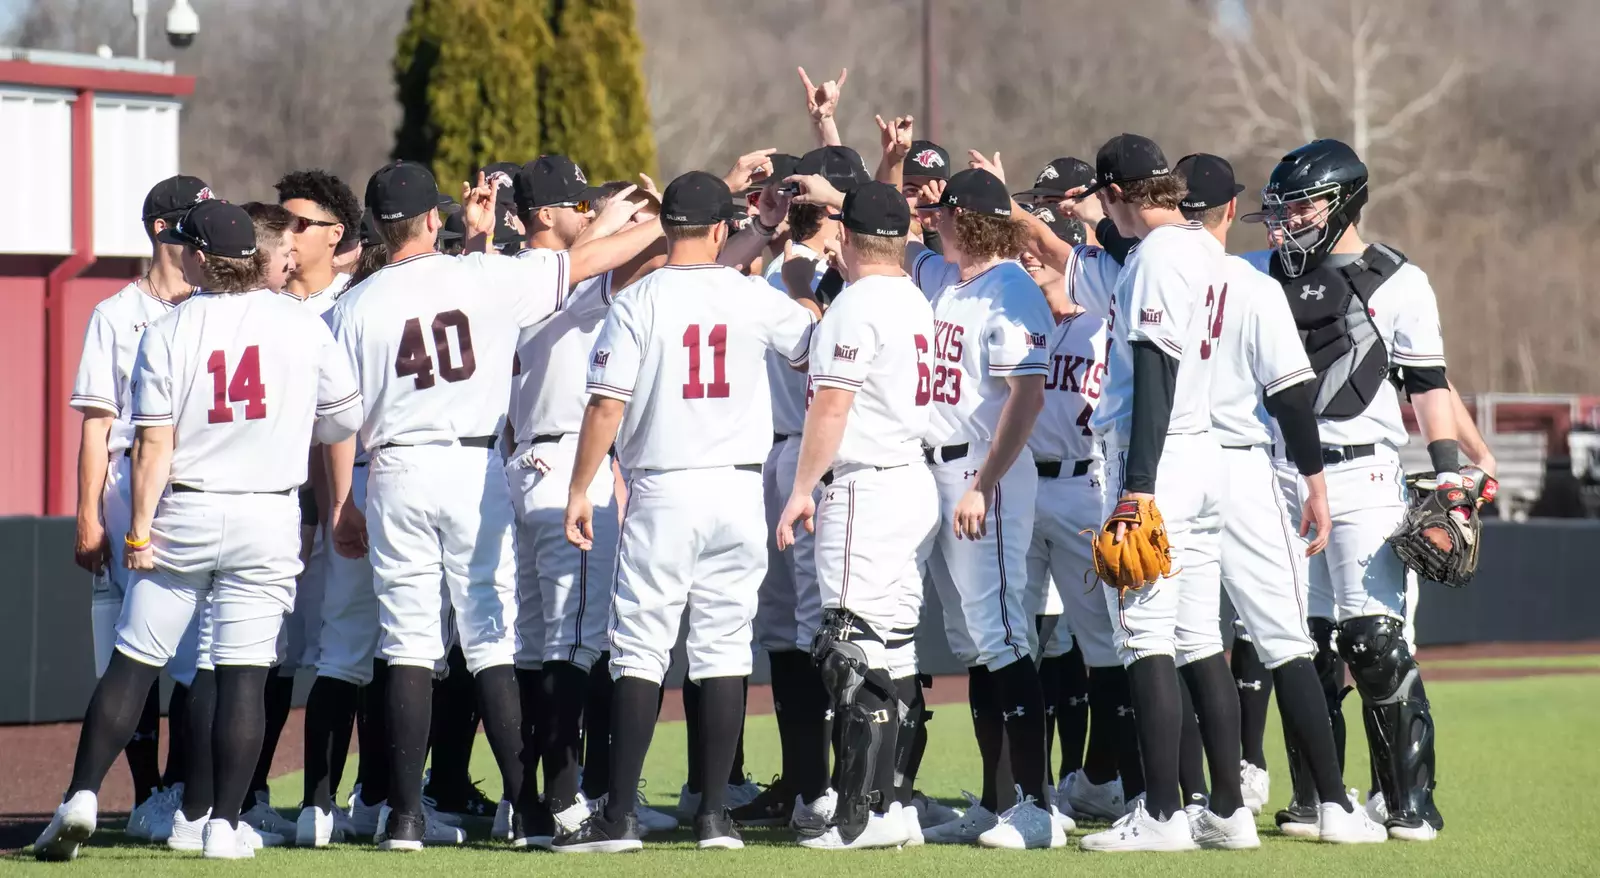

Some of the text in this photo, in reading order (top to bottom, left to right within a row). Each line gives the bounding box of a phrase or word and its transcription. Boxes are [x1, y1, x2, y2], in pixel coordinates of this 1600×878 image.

[394, 308, 477, 391] 40
[933, 319, 965, 363] KIS
[1200, 281, 1228, 361] 34
[206, 344, 267, 424] 14
[682, 323, 731, 400] 11
[932, 364, 963, 406] 23
